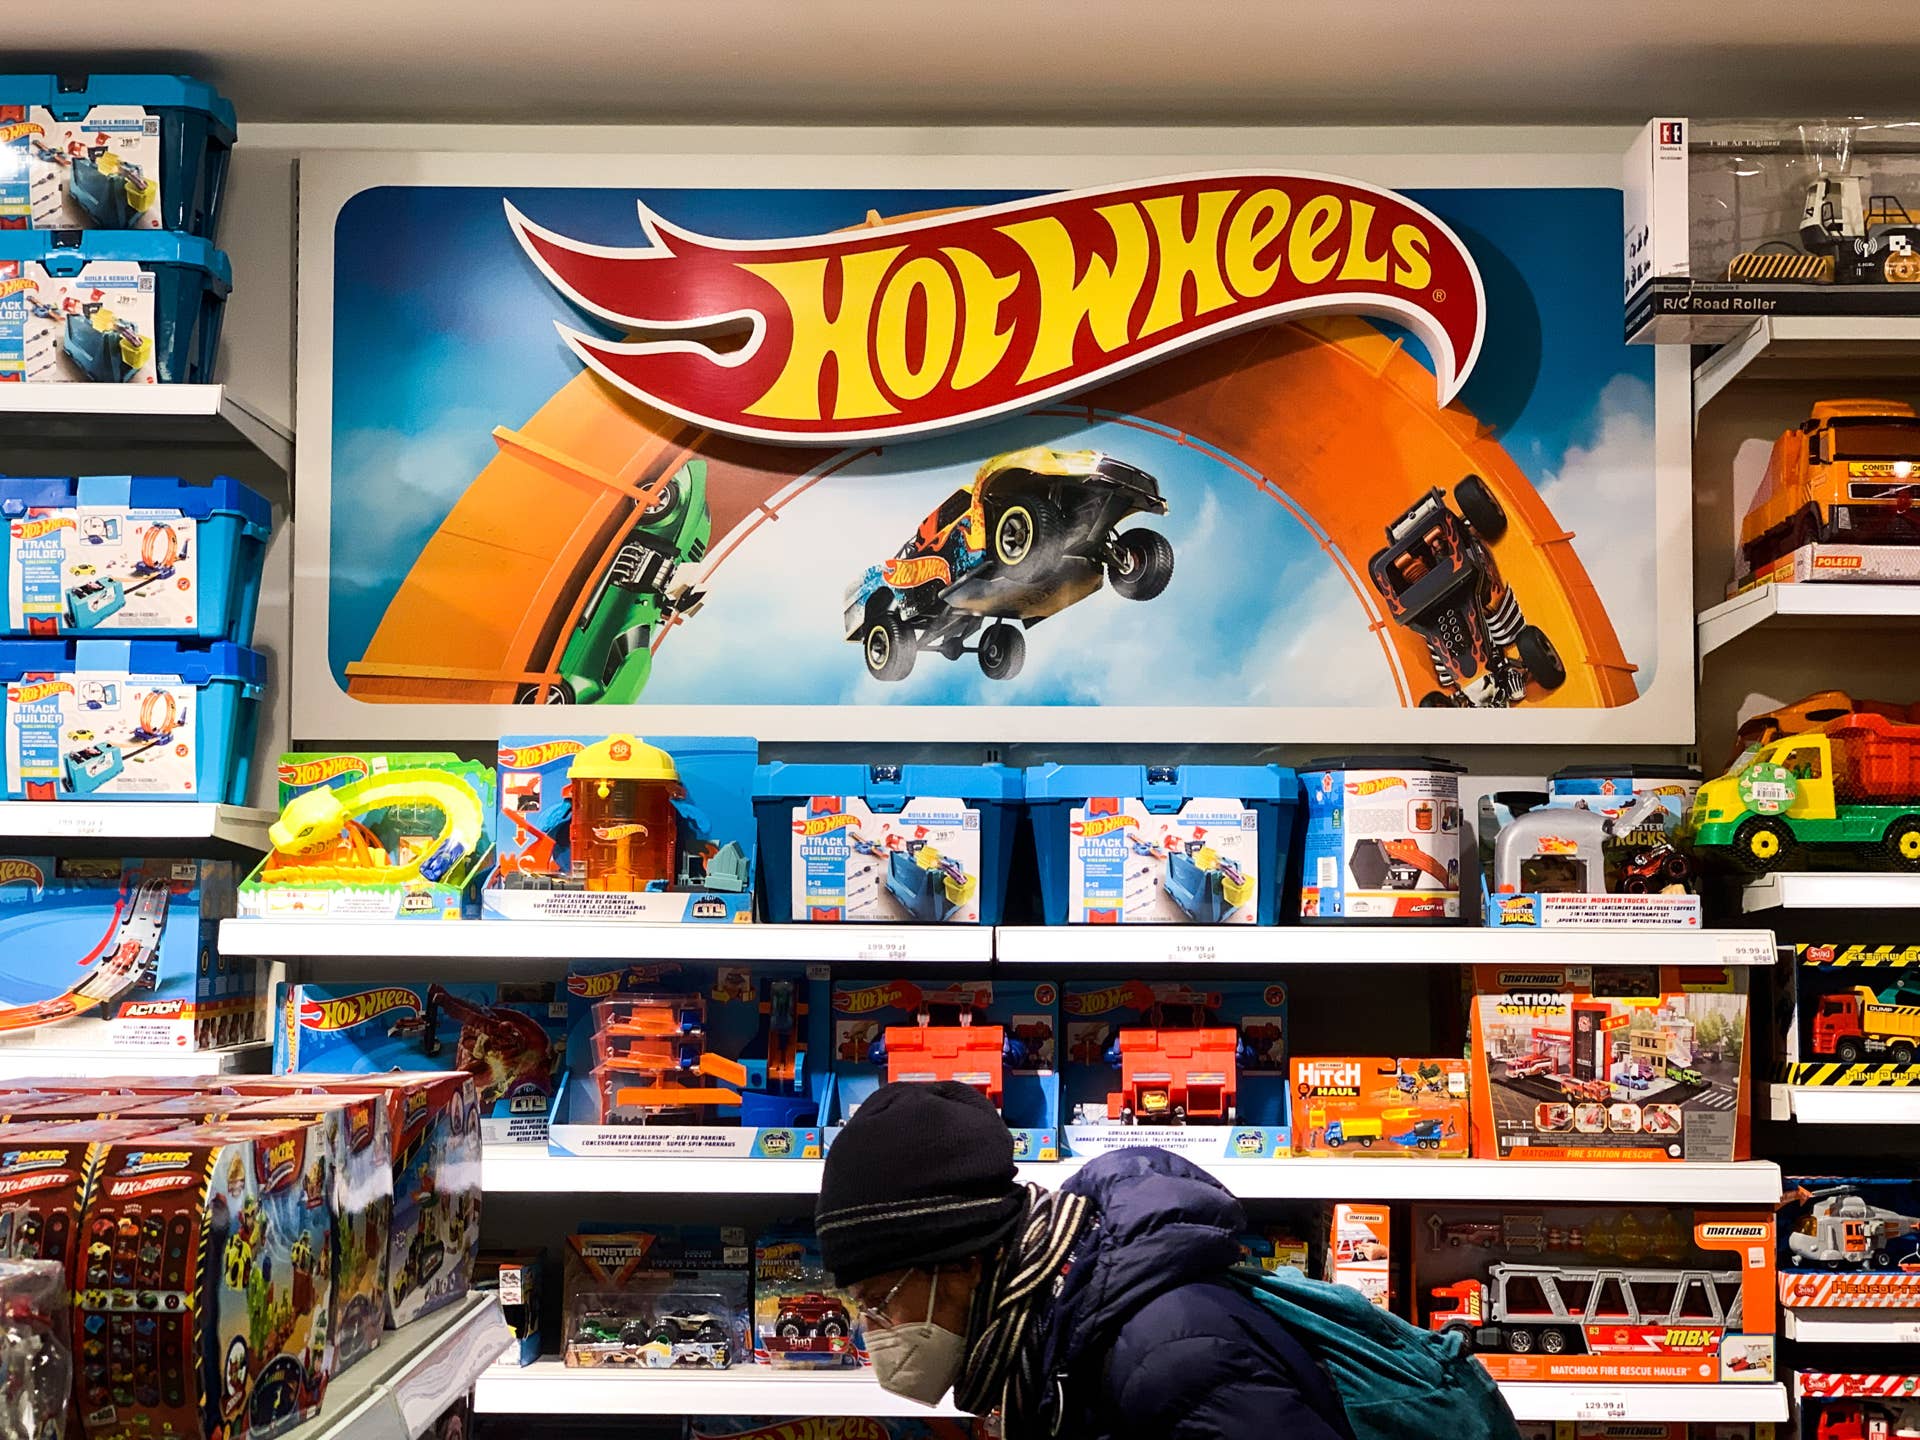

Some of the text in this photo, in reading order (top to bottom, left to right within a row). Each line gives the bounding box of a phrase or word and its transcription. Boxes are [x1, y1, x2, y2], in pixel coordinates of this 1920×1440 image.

[0, 302, 22, 310] ACK
[734, 186, 1432, 420] HOT WHEELS
[1663, 298, 1777, 310] R/C Road Roller
[0, 310, 27, 320] LDER
[22, 523, 43, 538] HOT
[24, 540, 58, 549] TRACK
[18, 550, 64, 560] BUILDER
[1817, 558, 1858, 566] POLESIE
[892, 559, 948, 584] HOT WHEELS
[18, 687, 40, 703] HOT
[21, 704, 56, 714] TRACK
[14, 714, 62, 724] BUILDER
[515, 746, 541, 767] HOT
[294, 757, 364, 785] HOT WHEELS
[804, 814, 860, 836] HOT WHEELS
[1082, 816, 1138, 836] HOT WHEELS
[807, 836, 844, 846] TRACK
[1085, 838, 1122, 847] TRACK
[802, 846, 850, 856] BUILDER
[1079, 848, 1128, 857] BUILDER
[1501, 913, 1536, 924] TRUCKS
[1503, 974, 1560, 984] MATCHBOX
[585, 974, 614, 995] HOT
[1500, 994, 1564, 1006] ACTION
[125, 1000, 182, 1016] ACTION
[318, 990, 416, 1029] HOT WHEELS
[1496, 1006, 1566, 1016] DRIVERS
[1298, 1063, 1360, 1086] HITCH
[604, 1080, 613, 1094] 2
[1317, 1088, 1357, 1096] HAUL
[1566, 1149, 1586, 1158] FIRE
[1586, 1150, 1620, 1158] STATION
[1622, 1150, 1654, 1159] RESCUE
[1706, 1227, 1764, 1236] MATCHBOX
[582, 1248, 642, 1257] MONSTER
[599, 1257, 626, 1266] JAM
[1664, 1329, 1714, 1346] MBX
[1550, 1366, 1687, 1376] MATCHBOX FIRE RESCUE HAULER
